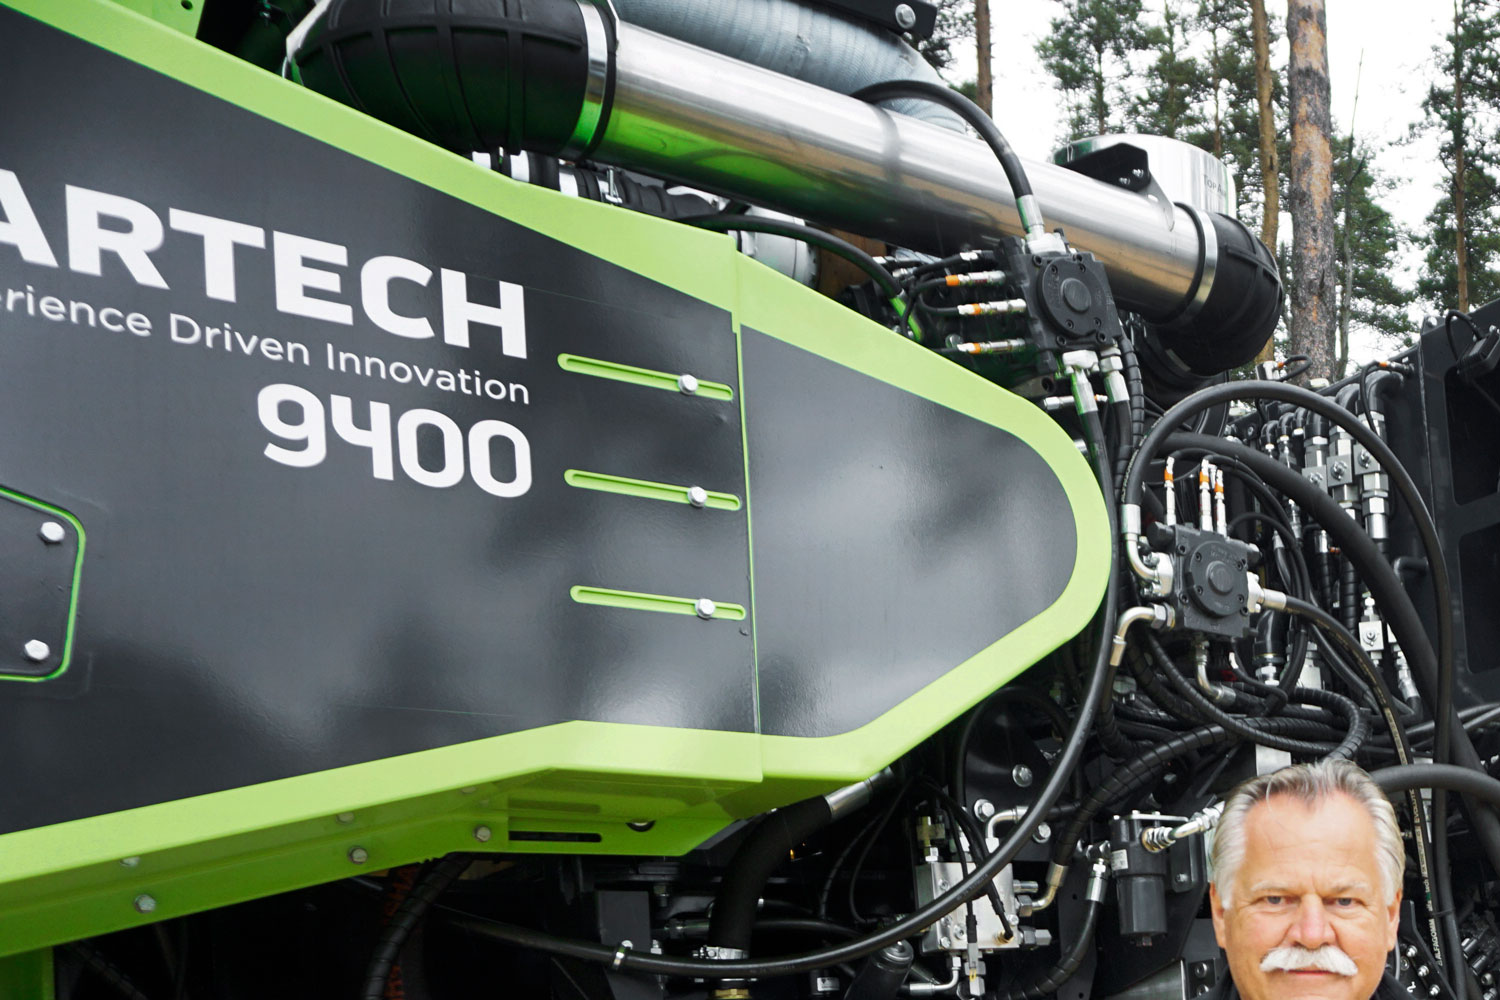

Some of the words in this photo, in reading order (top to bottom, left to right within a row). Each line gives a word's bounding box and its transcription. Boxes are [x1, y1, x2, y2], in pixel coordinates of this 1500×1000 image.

[0, 284, 153, 337] rience
[169, 312, 310, 366] Driven
[327, 343, 530, 405] Innovation
[257, 383, 533, 498] 9400
